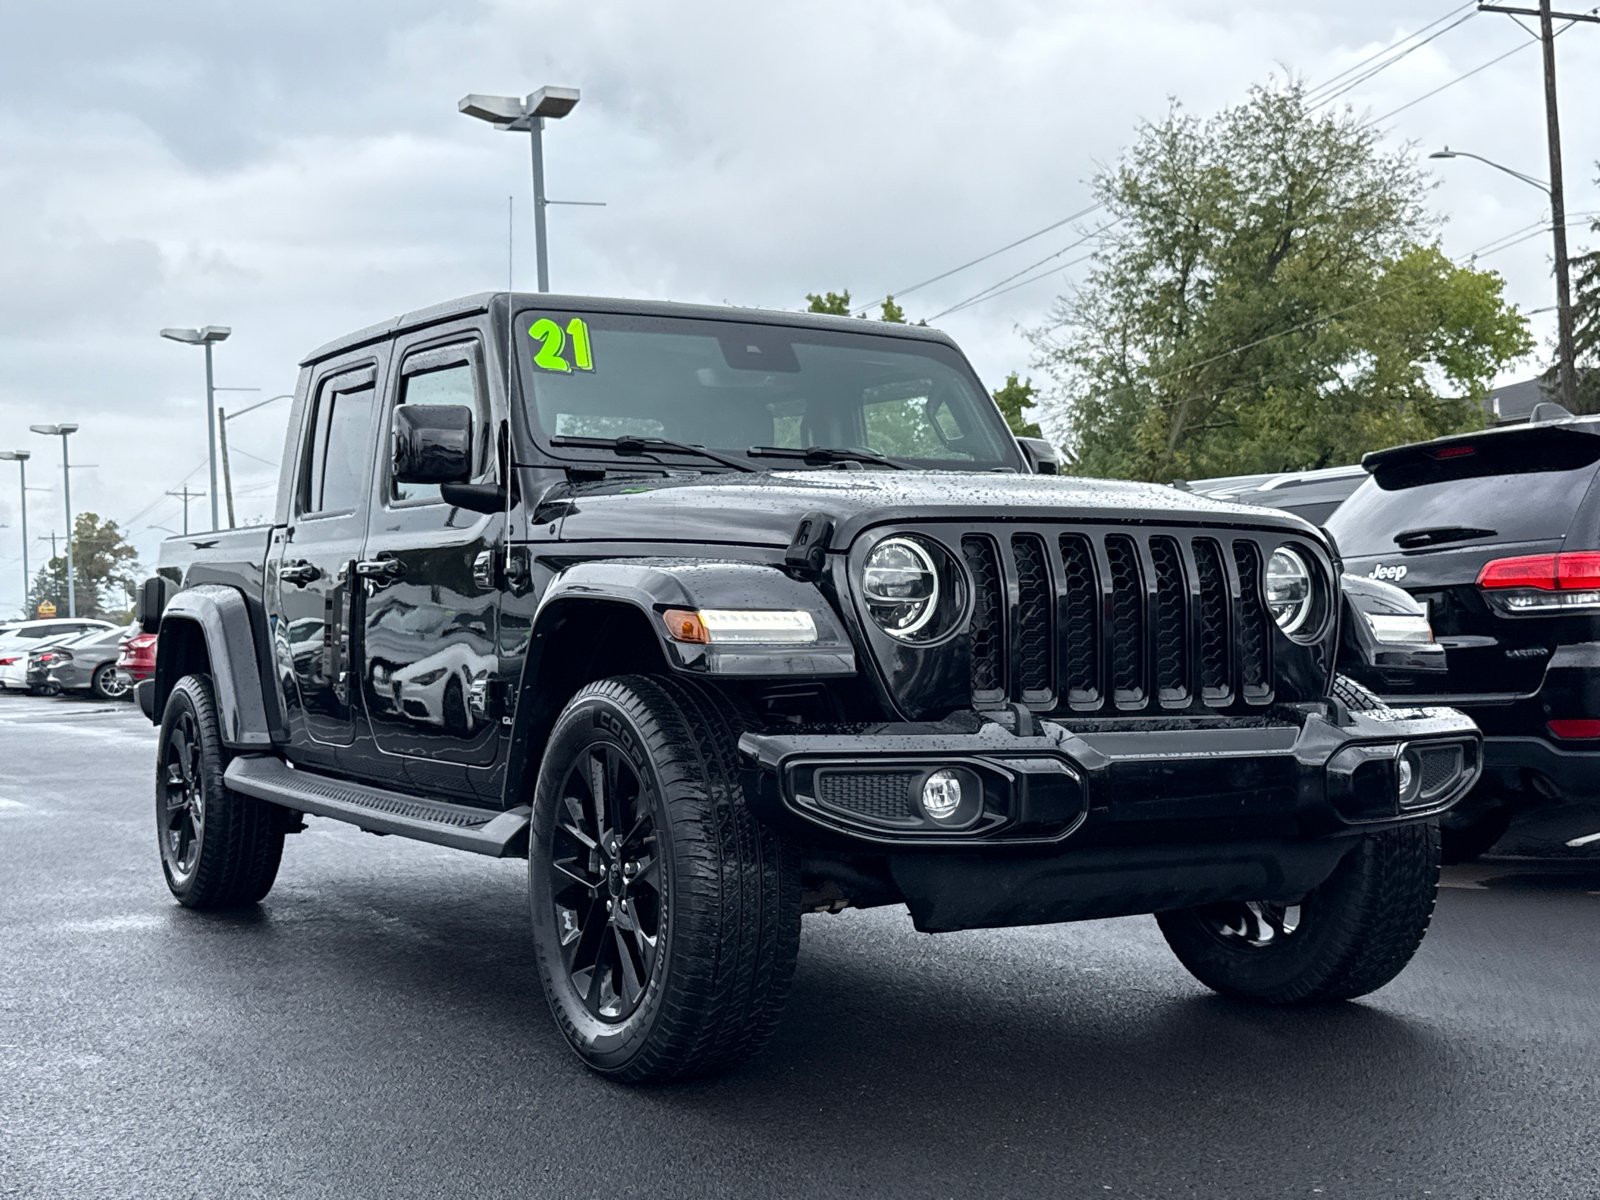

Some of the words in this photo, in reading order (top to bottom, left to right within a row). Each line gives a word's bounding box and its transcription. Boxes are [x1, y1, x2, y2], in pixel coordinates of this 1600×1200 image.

[528, 318, 594, 373] 21
[1368, 563, 1407, 581] Jeep
[600, 710, 658, 812] COOPER
